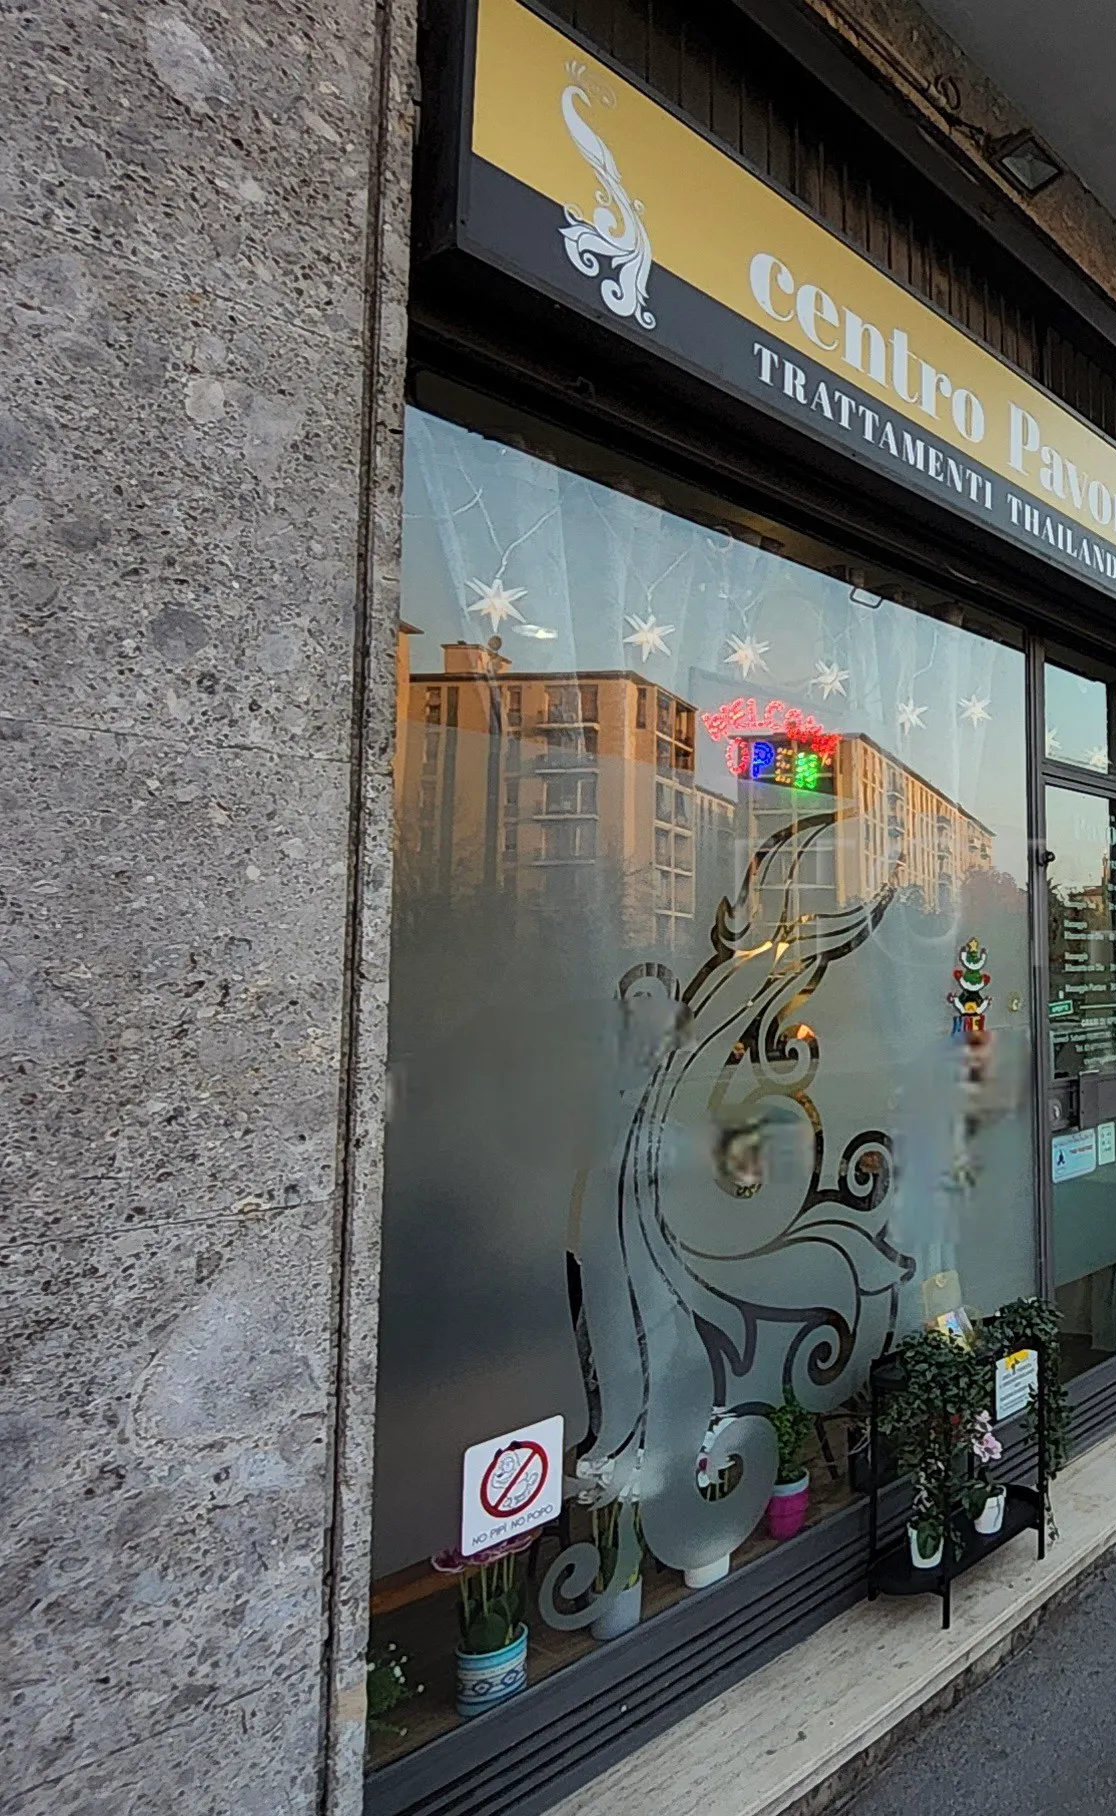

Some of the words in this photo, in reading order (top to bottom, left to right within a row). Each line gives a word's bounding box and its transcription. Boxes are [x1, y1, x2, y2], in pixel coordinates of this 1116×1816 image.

[749, 252, 985, 443] centro
[753, 342, 993, 510] TRATTAMENTI
[472, 1533, 487, 1546] NO
[511, 1517, 525, 1529] NO
